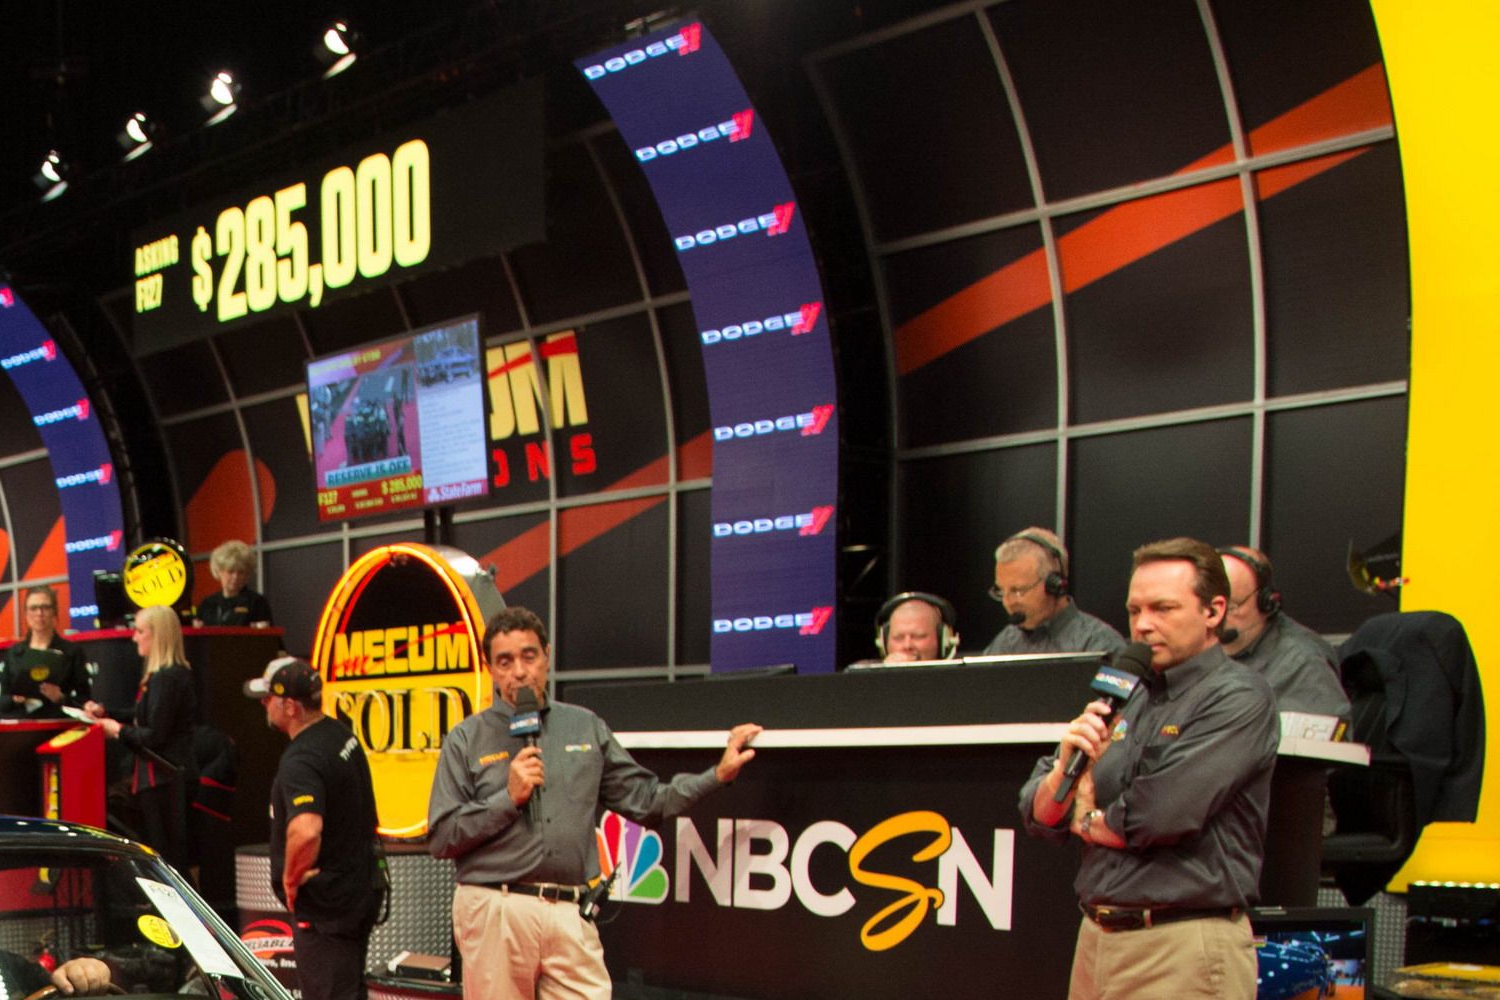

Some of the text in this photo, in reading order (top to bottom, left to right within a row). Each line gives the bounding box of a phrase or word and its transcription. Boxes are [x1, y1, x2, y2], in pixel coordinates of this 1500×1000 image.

[583, 33, 688, 80] DODGE
[635, 119, 740, 162] DODGE
[674, 211, 779, 251] DODGE
[135, 234, 179, 277] ASKING
[135, 273, 163, 313] F127
[701, 310, 804, 345] DODGE
[714, 411, 815, 442] DODGE
[713, 512, 814, 538] DODGE
[713, 612, 814, 633] DODGE
[334, 620, 470, 678] MECUM
[334, 685, 473, 753] SOLD
[674, 809, 1016, 952] NBCSN
